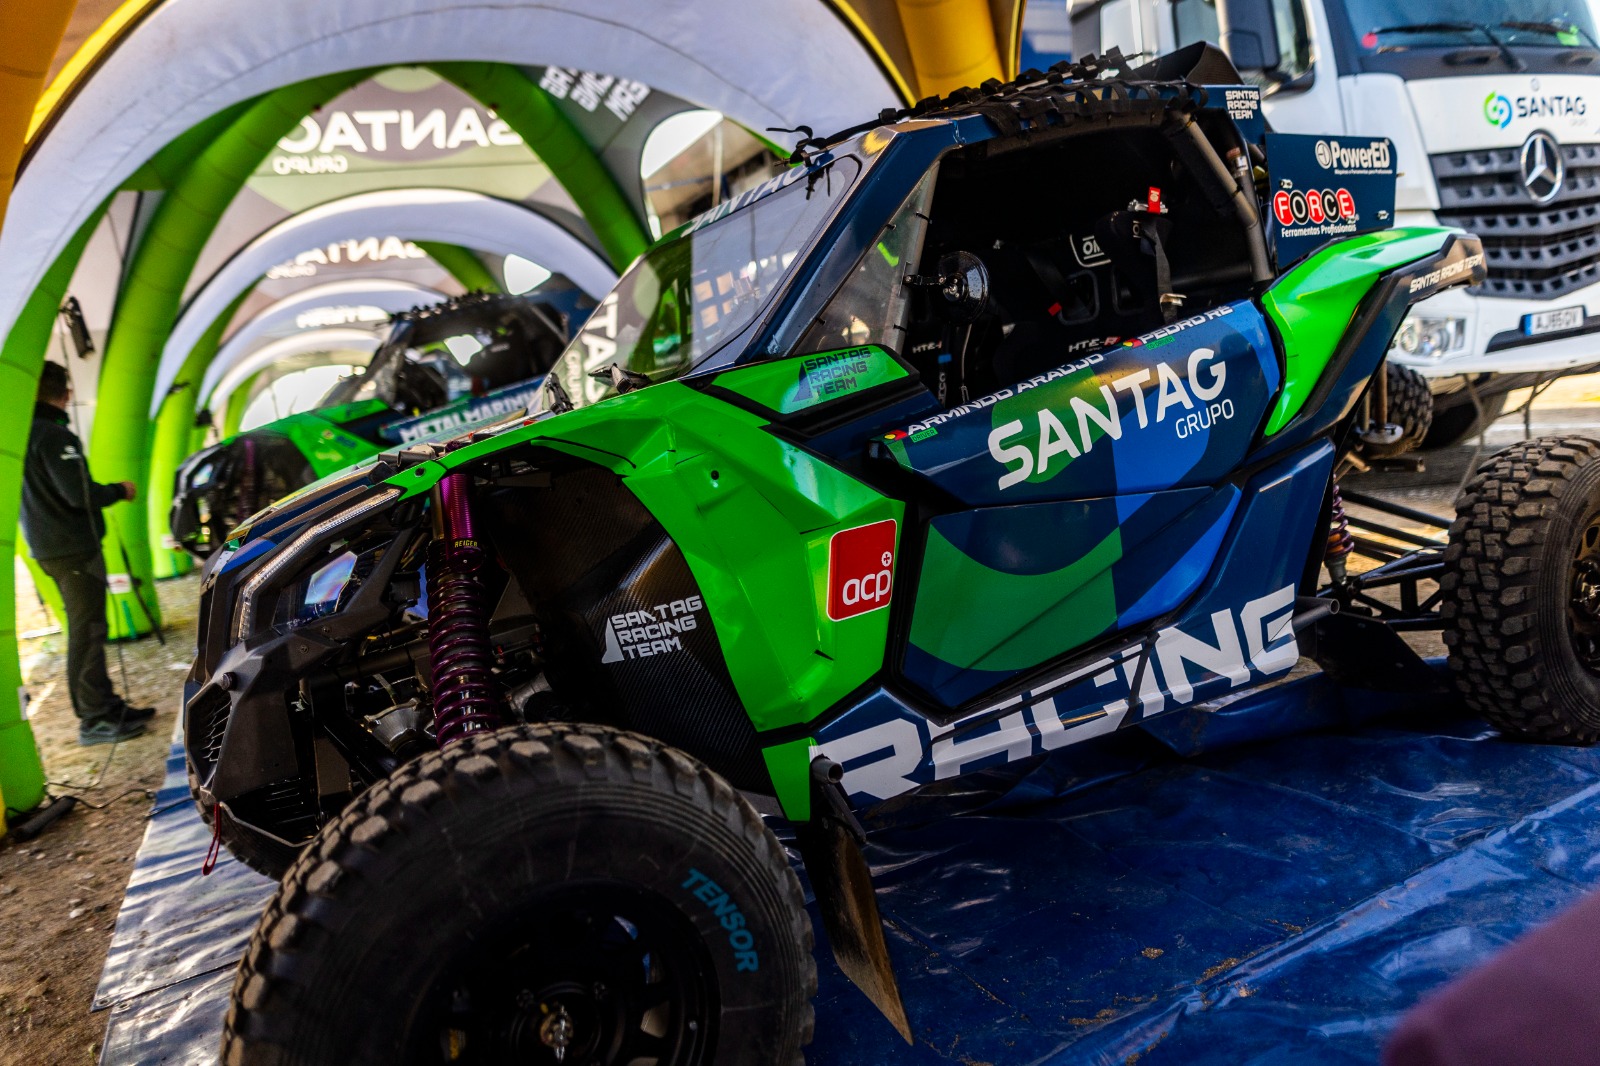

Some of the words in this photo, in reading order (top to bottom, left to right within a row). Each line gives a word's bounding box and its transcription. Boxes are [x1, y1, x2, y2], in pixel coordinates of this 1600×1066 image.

[1225, 90, 1259, 100] SANTAG
[1227, 100, 1258, 110] RACING
[1516, 96, 1586, 118] SANTAG
[1228, 109, 1253, 120] TEAM
[1330, 141, 1390, 168] PowerED
[1277, 193, 1352, 220] FORCE
[1281, 227, 1320, 238] Ferramentas
[1321, 224, 1357, 236] Profissionais
[1409, 269, 1441, 294] SANTAG
[1440, 259, 1465, 280] RACING
[1138, 315, 1207, 345] PEDRO
[912, 341, 943, 354] HTE-
[1069, 336, 1120, 353] HTE-R
[804, 347, 871, 372] SANTAG
[809, 361, 868, 384] RACING
[811, 377, 858, 397] TEAM
[908, 388, 1014, 436] ARMINDO
[987, 347, 1227, 491] SANTAG
[1175, 398, 1235, 439] GRUPO
[911, 429, 936, 443] DRIVER
[454, 540, 478, 548] REIGER
[842, 569, 892, 605] acp
[611, 595, 703, 629] SANTAG
[616, 614, 697, 645] RACING
[622, 636, 682, 659] TEAM
[808, 583, 1299, 800] RACING
[681, 867, 759, 972] TENSOR
